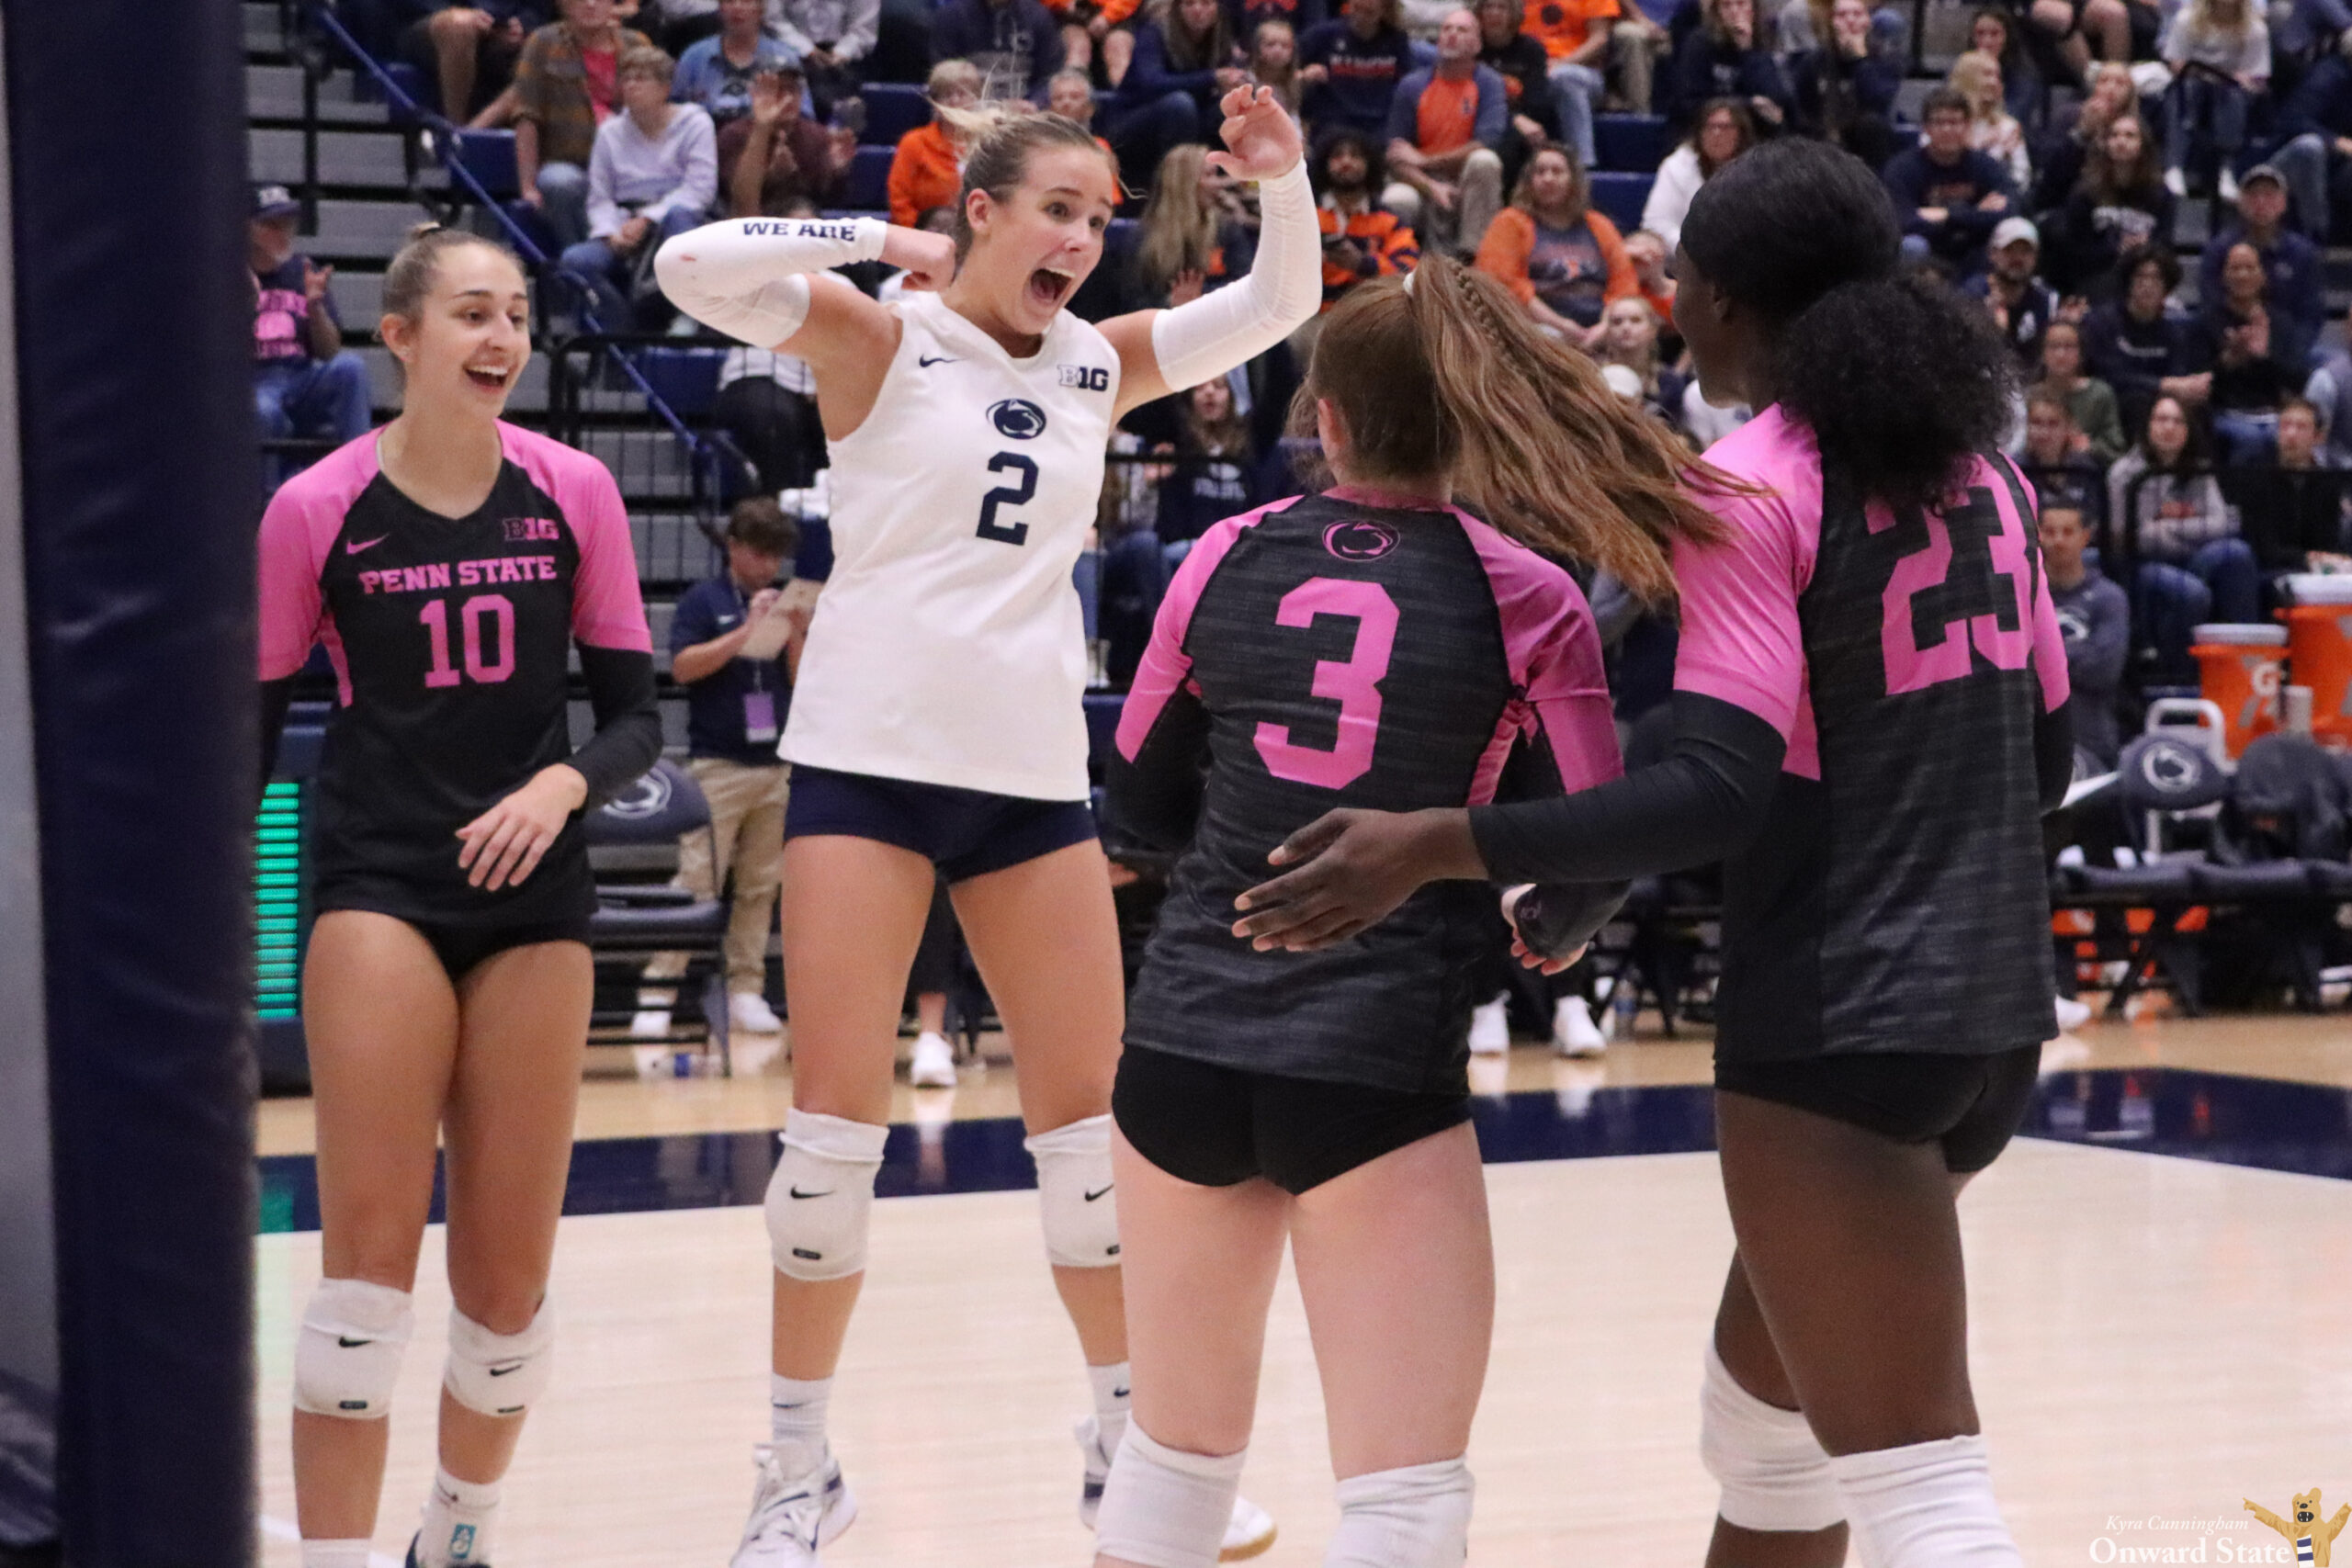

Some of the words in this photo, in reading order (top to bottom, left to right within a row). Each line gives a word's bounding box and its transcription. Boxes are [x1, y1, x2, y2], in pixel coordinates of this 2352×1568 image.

[742, 222, 789, 236] WE
[976, 451, 1039, 547] 2
[358, 563, 451, 594] PENN
[458, 556, 557, 586] STATE
[1864, 455, 2034, 696] 23
[419, 593, 515, 687] 10
[1253, 576, 1400, 790] 3
